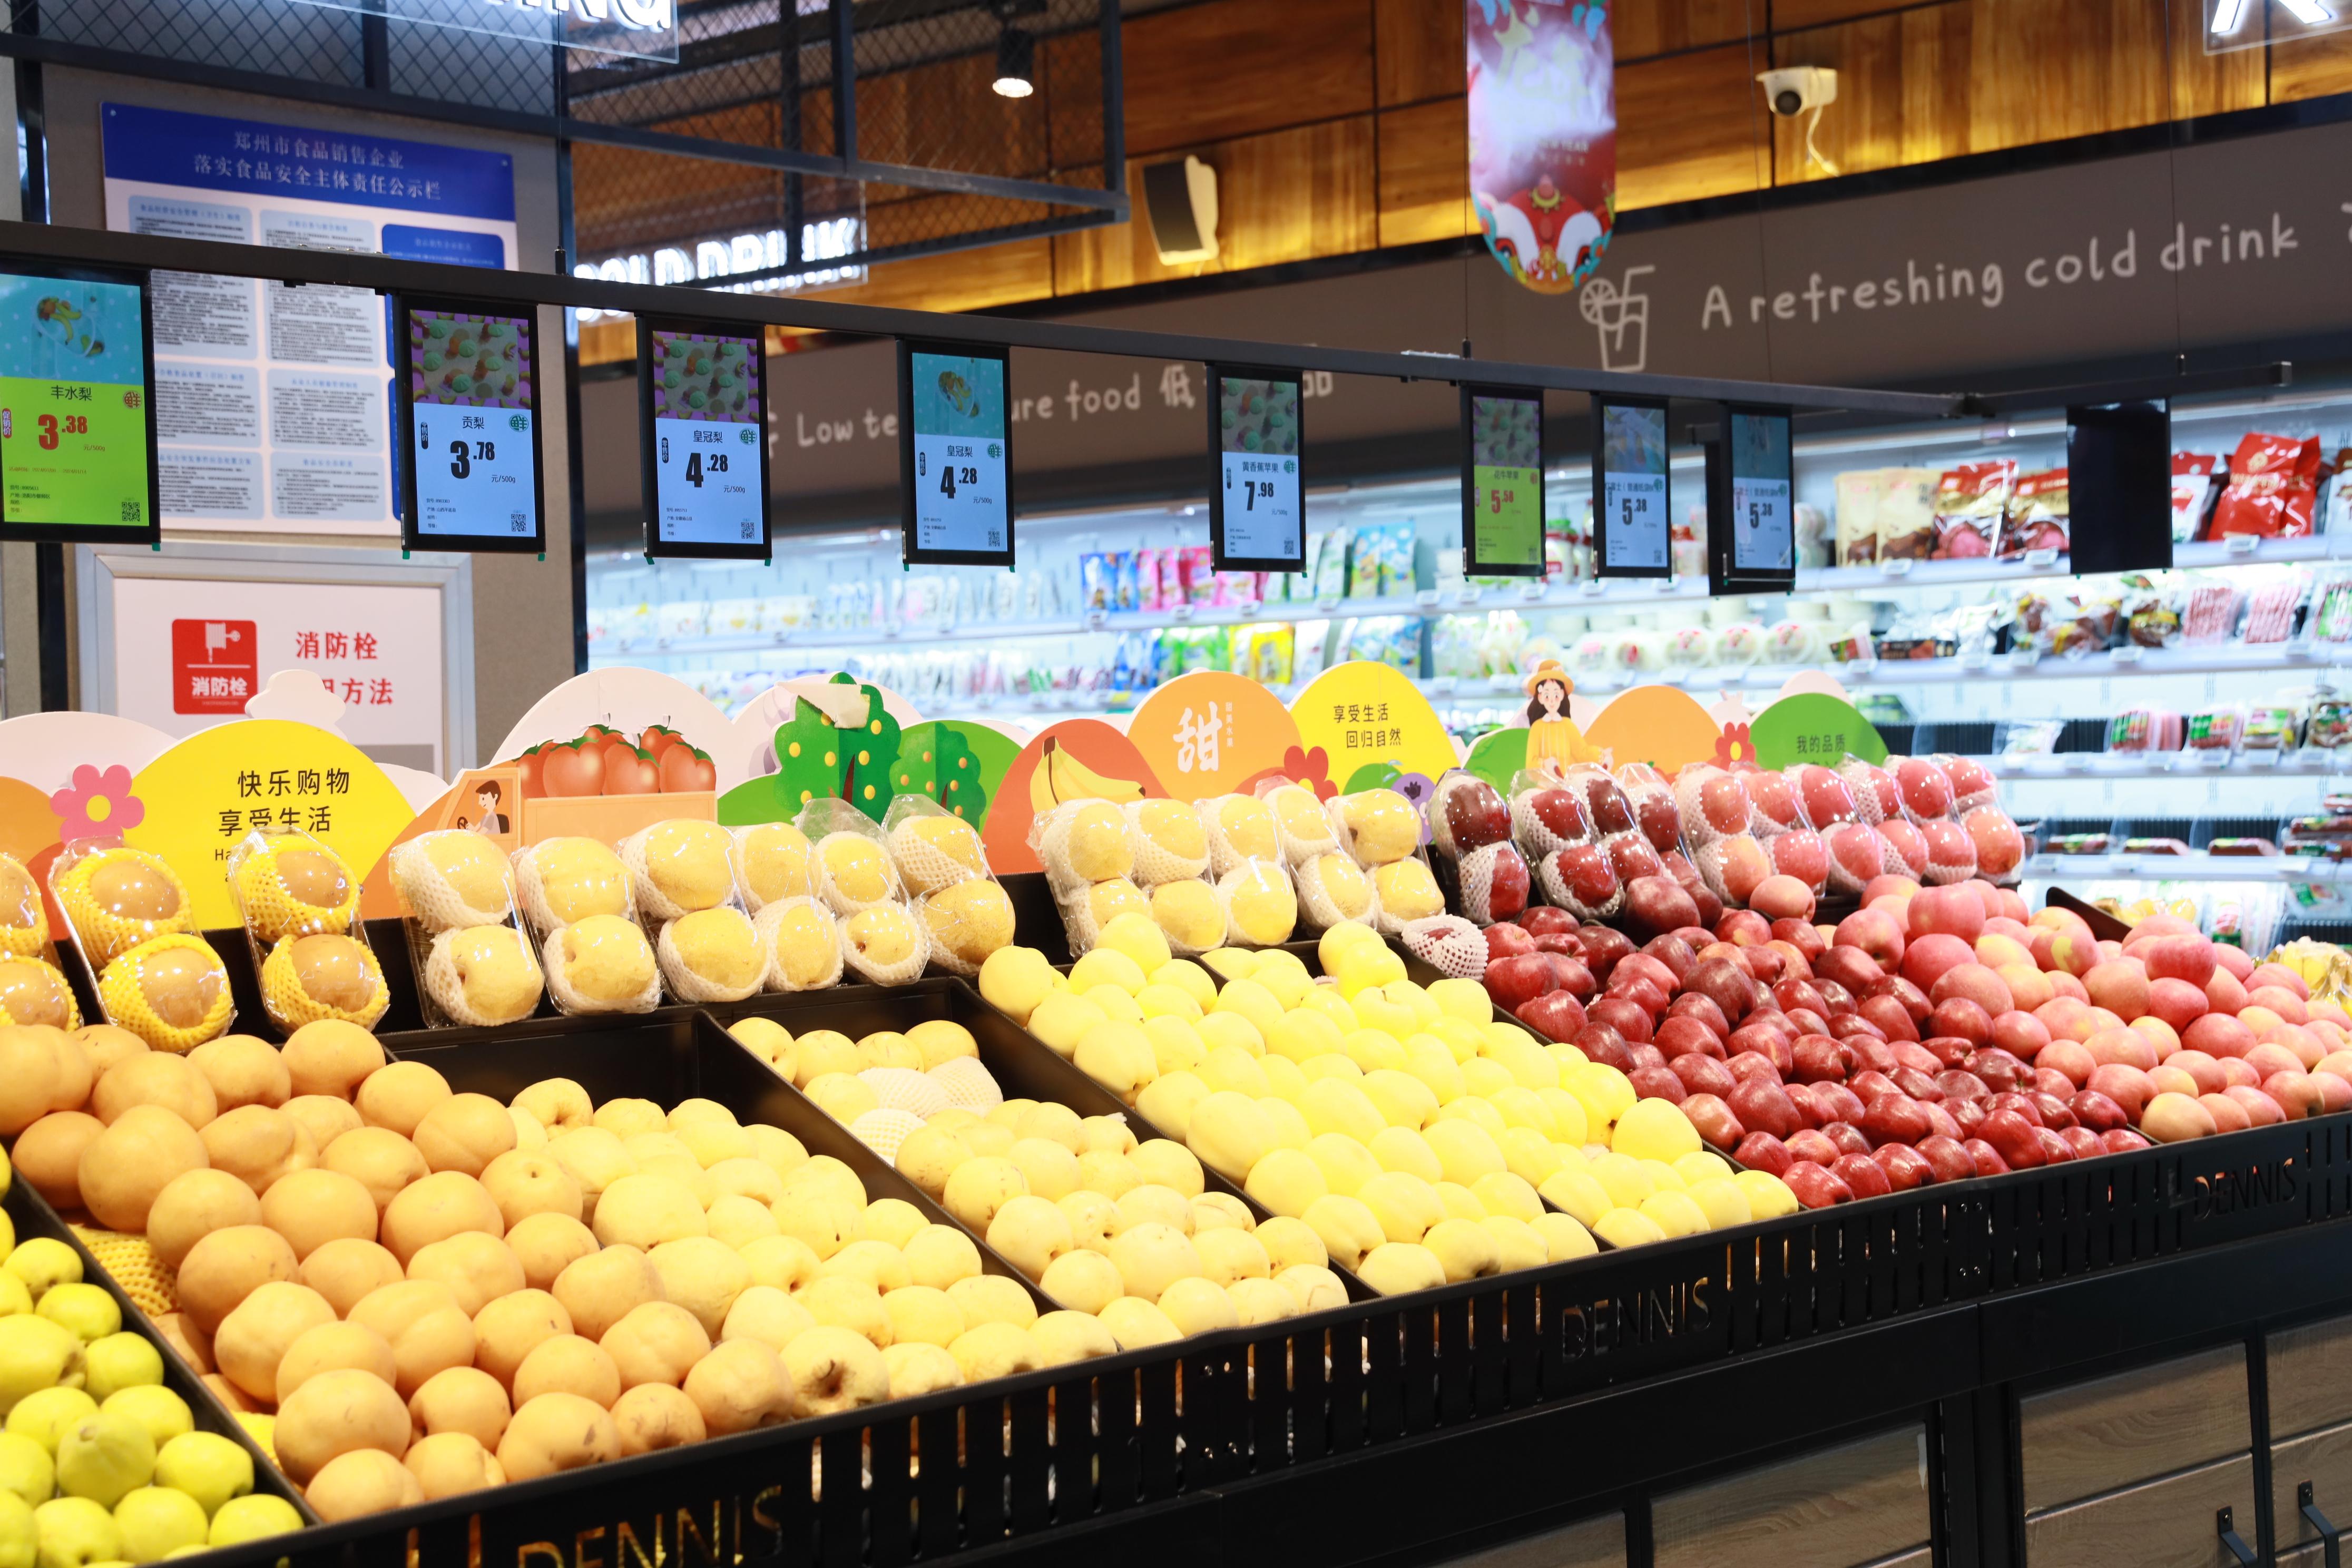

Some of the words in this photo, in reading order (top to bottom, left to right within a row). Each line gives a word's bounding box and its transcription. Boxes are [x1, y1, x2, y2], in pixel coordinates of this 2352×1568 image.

[234, 131, 404, 169] 郑州市食品销售企业
[194, 154, 442, 200] 落实食品安全主体责任公示栏
[1701, 285, 1732, 329] A
[1749, 259, 2003, 322] refreshing
[2025, 228, 2137, 288] cold
[2159, 212, 2298, 271] drink
[51, 385, 92, 401] 丰水梨
[796, 411, 854, 448] Low
[1064, 371, 1141, 421] food
[3, 410, 12, 436] 促销价
[462, 416, 485, 429] 贡梨
[693, 430, 723, 444] 皇冠梨
[947, 445, 973, 458] 皇冠梨
[1242, 461, 1279, 473] 黄香蕉苹果
[491, 474, 516, 484] 元/500g
[723, 485, 746, 494] 元/500g
[973, 496, 992, 505] 元/500g
[296, 630, 378, 660] 消防栓
[191, 677, 248, 697] 消防栓
[1333, 703, 1389, 723] 享受生活
[1173, 701, 1222, 773] 甜
[1346, 728, 1402, 749] 回归自然
[1797, 733, 1845, 754] 我的品质
[238, 768, 350, 798] 快乐购物
[219, 806, 331, 837] 享受生活
[2193, 1157, 2296, 1222] DENNIS
[1562, 1277, 1711, 1364] DENNIS
